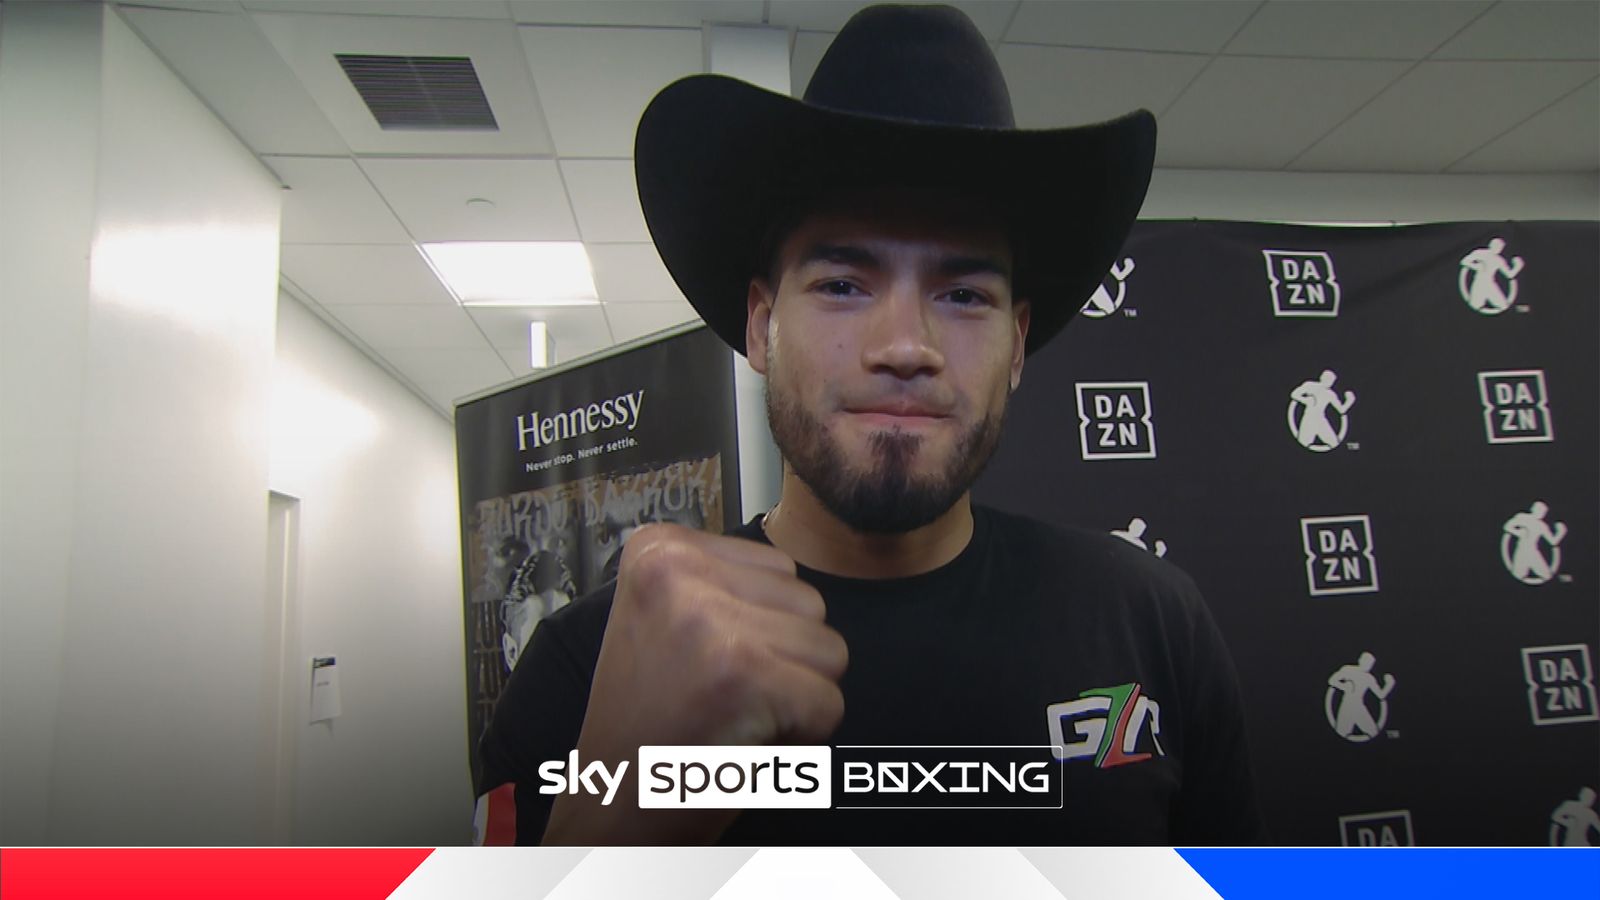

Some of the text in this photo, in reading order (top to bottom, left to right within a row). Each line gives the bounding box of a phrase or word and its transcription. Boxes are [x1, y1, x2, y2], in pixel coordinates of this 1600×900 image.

[1282, 259, 1321, 280] DA
[1286, 283, 1325, 304] ZN
[1495, 382, 1534, 405] DA
[1094, 394, 1136, 418] DA
[518, 390, 643, 451] Hennessy
[1499, 408, 1536, 431] ZN
[1097, 422, 1138, 446] ZN
[526, 437, 638, 472] Never stop. Never settle.
[1319, 529, 1359, 553] DA
[1322, 556, 1361, 582] ZN
[1539, 658, 1578, 683] DA
[1544, 684, 1583, 712] ZN
